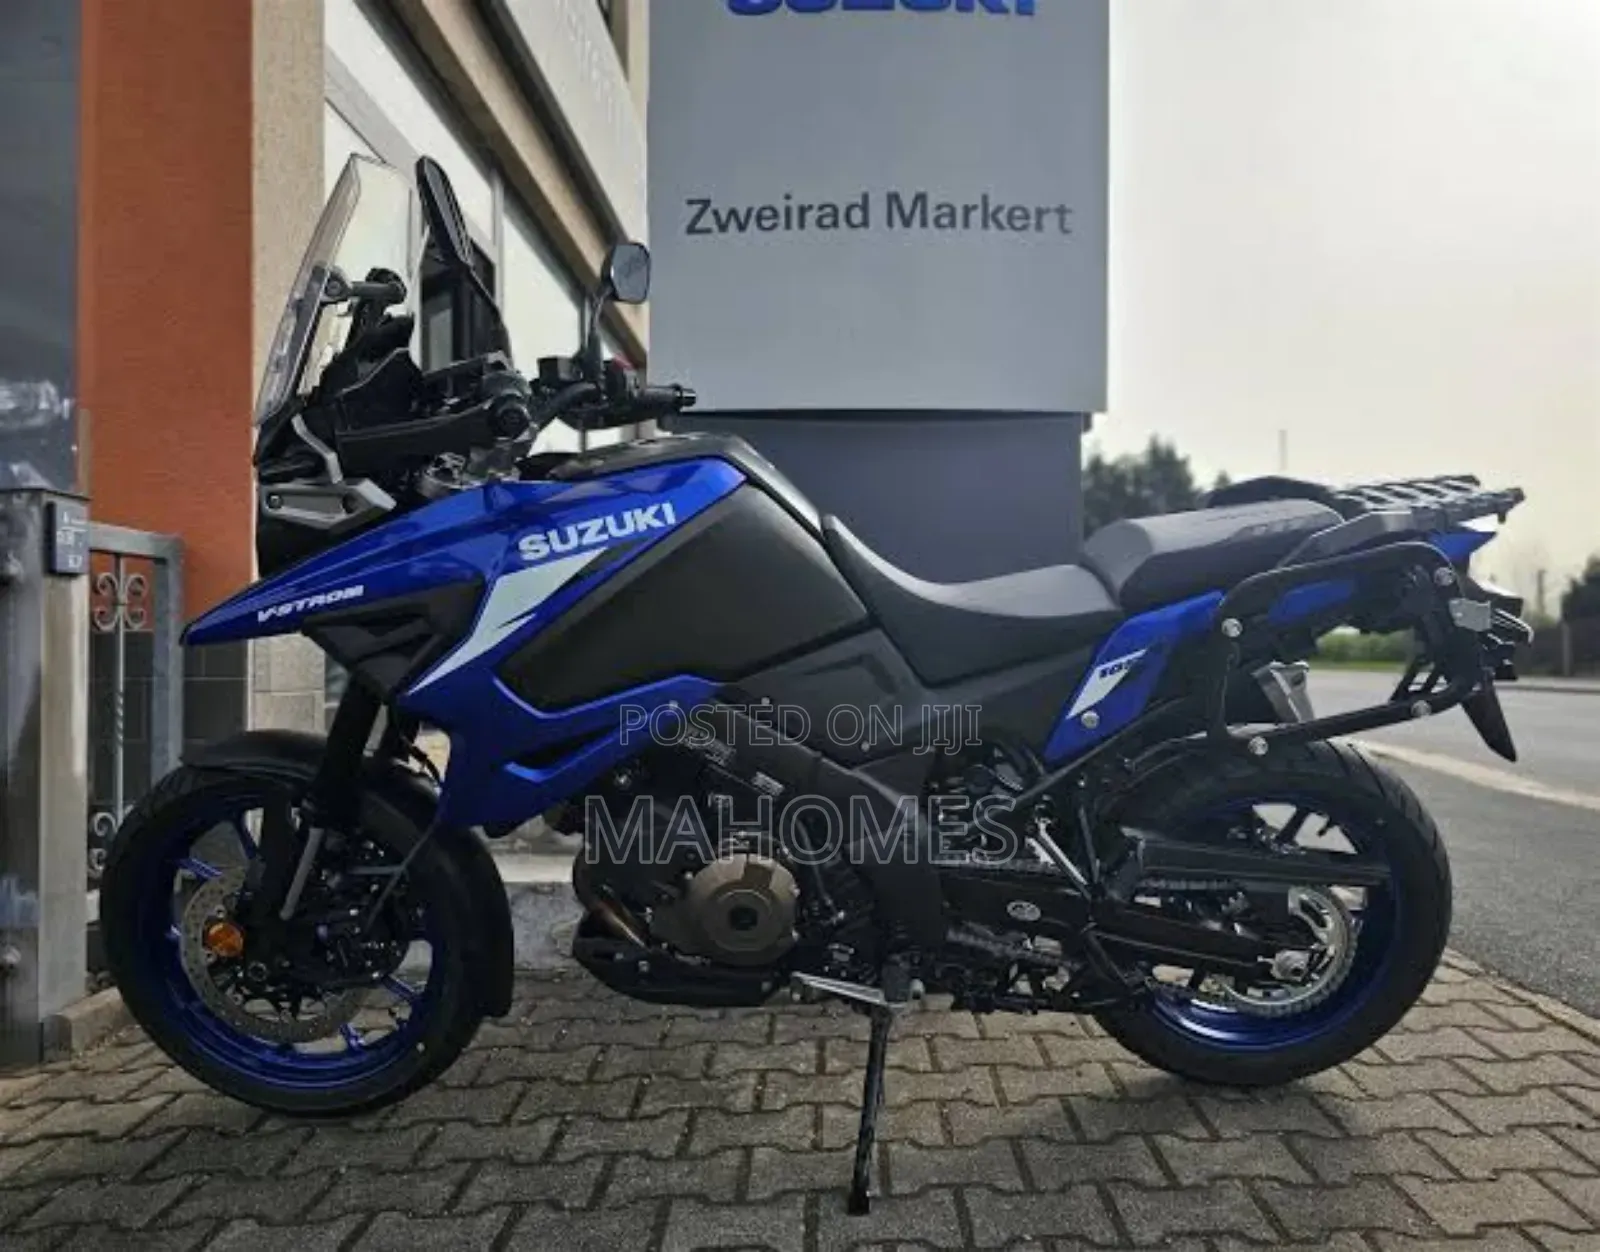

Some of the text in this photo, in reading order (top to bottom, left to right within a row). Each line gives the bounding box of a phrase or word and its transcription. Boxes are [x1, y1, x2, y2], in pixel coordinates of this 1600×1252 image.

[686, 192, 1073, 235] Zweirad Markert
[518, 502, 676, 561] SUZUKI
